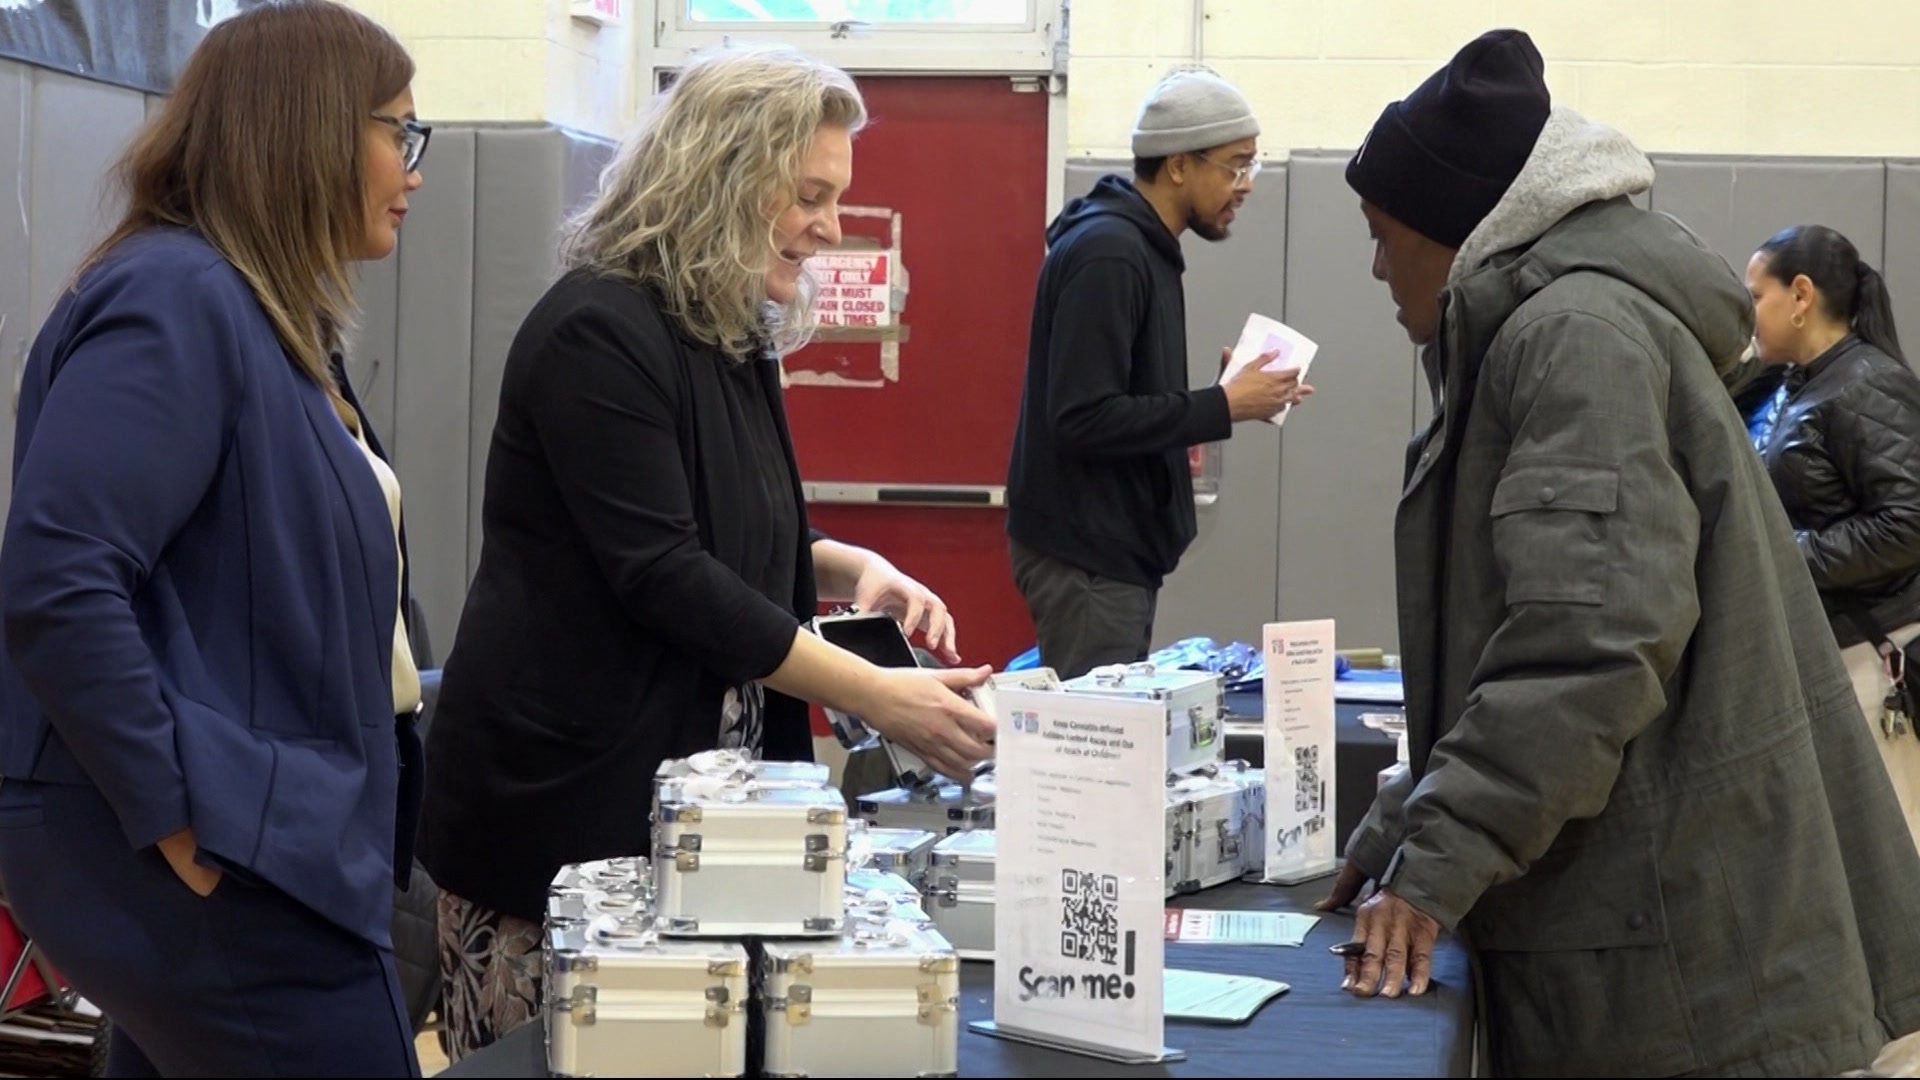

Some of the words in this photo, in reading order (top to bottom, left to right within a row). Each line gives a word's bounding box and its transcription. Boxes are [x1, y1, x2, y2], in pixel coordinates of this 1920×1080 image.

[841, 288, 872, 298] MUST
[842, 301, 885, 312] CLOSED
[820, 314, 838, 325] ALL
[843, 315, 877, 327] TIMES
[1018, 966, 1076, 1001] Scan
